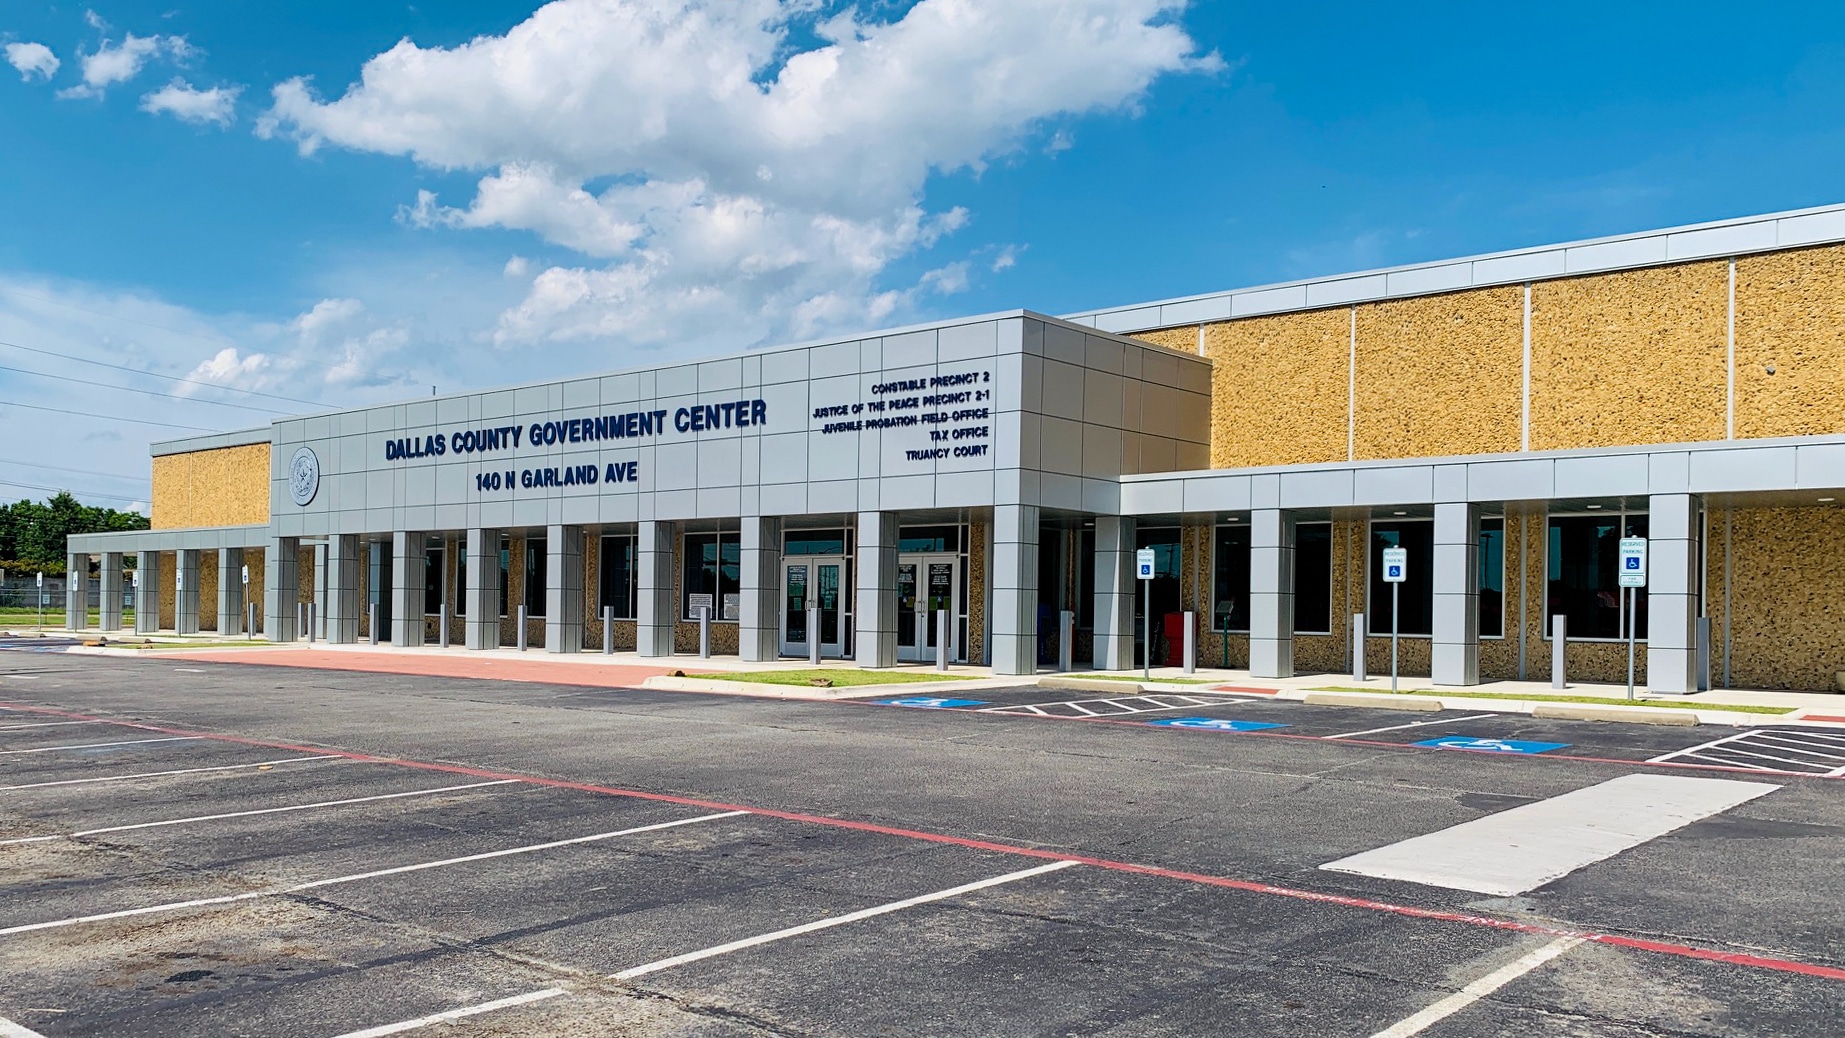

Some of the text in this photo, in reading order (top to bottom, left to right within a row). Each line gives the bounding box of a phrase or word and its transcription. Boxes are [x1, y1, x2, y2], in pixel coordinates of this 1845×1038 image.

[871, 371, 990, 395] CONSTABLE PRECINCT 2
[813, 389, 990, 419] JUSTICE OF THE PEACE PRECINCT 2-1
[385, 399, 767, 461] DALLAS COUNTY GOVERNMENT CENTER
[822, 408, 989, 434] JUVENILE PROBATION FIELD OFFICE
[930, 426, 989, 442] TAX OFFICE
[906, 444, 988, 461] TRUANCY COURT
[476, 461, 638, 492] 140 N GARLAND AVE
